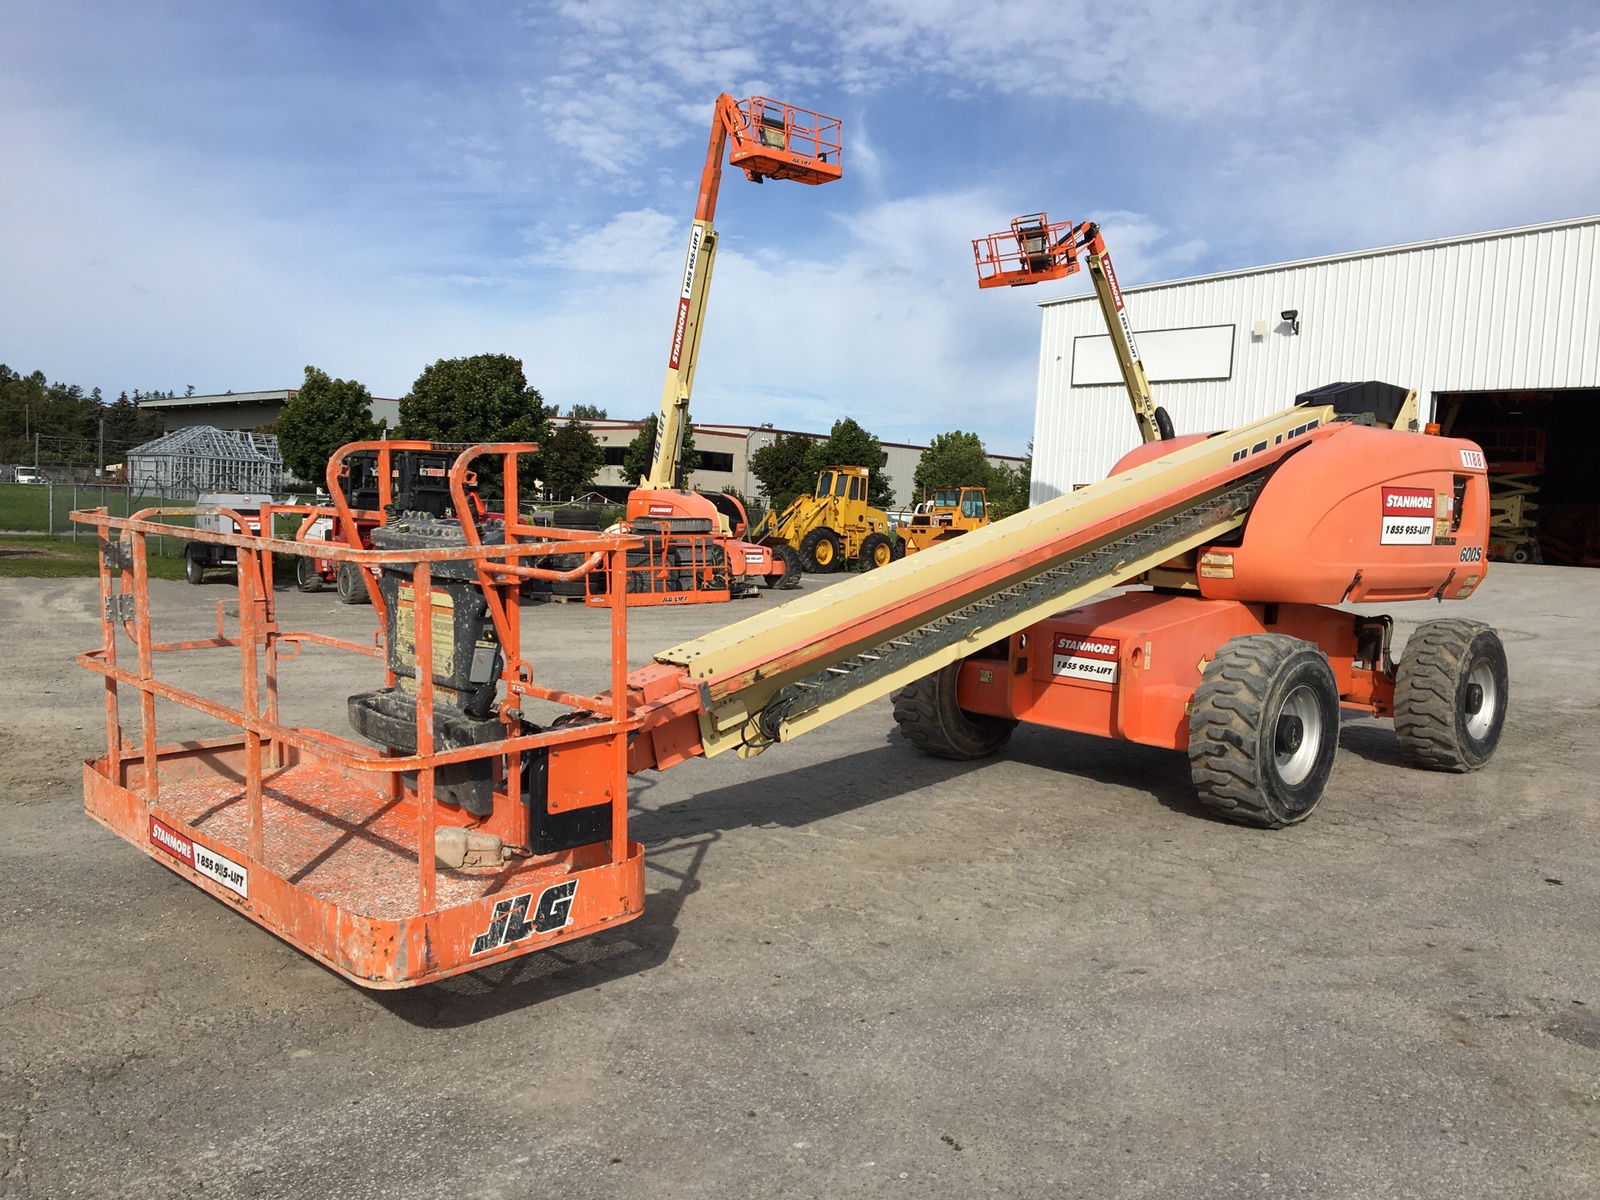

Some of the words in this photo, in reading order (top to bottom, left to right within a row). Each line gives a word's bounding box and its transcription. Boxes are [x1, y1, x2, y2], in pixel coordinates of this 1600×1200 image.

[688, 231, 699, 270] 955-LIFT
[685, 271, 693, 288] 855
[1103, 259, 1121, 307] STANMORE
[1125, 330, 1137, 358] 955-LIFT
[672, 302, 687, 364] STANMORE
[653, 441, 661, 464] JLG
[658, 409, 666, 439] LIFT
[1463, 451, 1482, 468] 1188
[1386, 494, 1433, 509] STANMORE
[1385, 525, 1390, 534] 1
[1390, 525, 1404, 534] 855
[1405, 525, 1431, 535] 955-LIFT
[1460, 546, 1482, 563] 600S
[1058, 639, 1117, 654] STANMORE
[1061, 661, 1077, 670] 855
[1078, 664, 1113, 675] 955-LIFT
[152, 824, 192, 859] STANMORE
[196, 853, 200, 864] 1
[200, 855, 213, 871] 855
[214, 862, 244, 887] 955-LIFT
[469, 878, 580, 957] JLG
